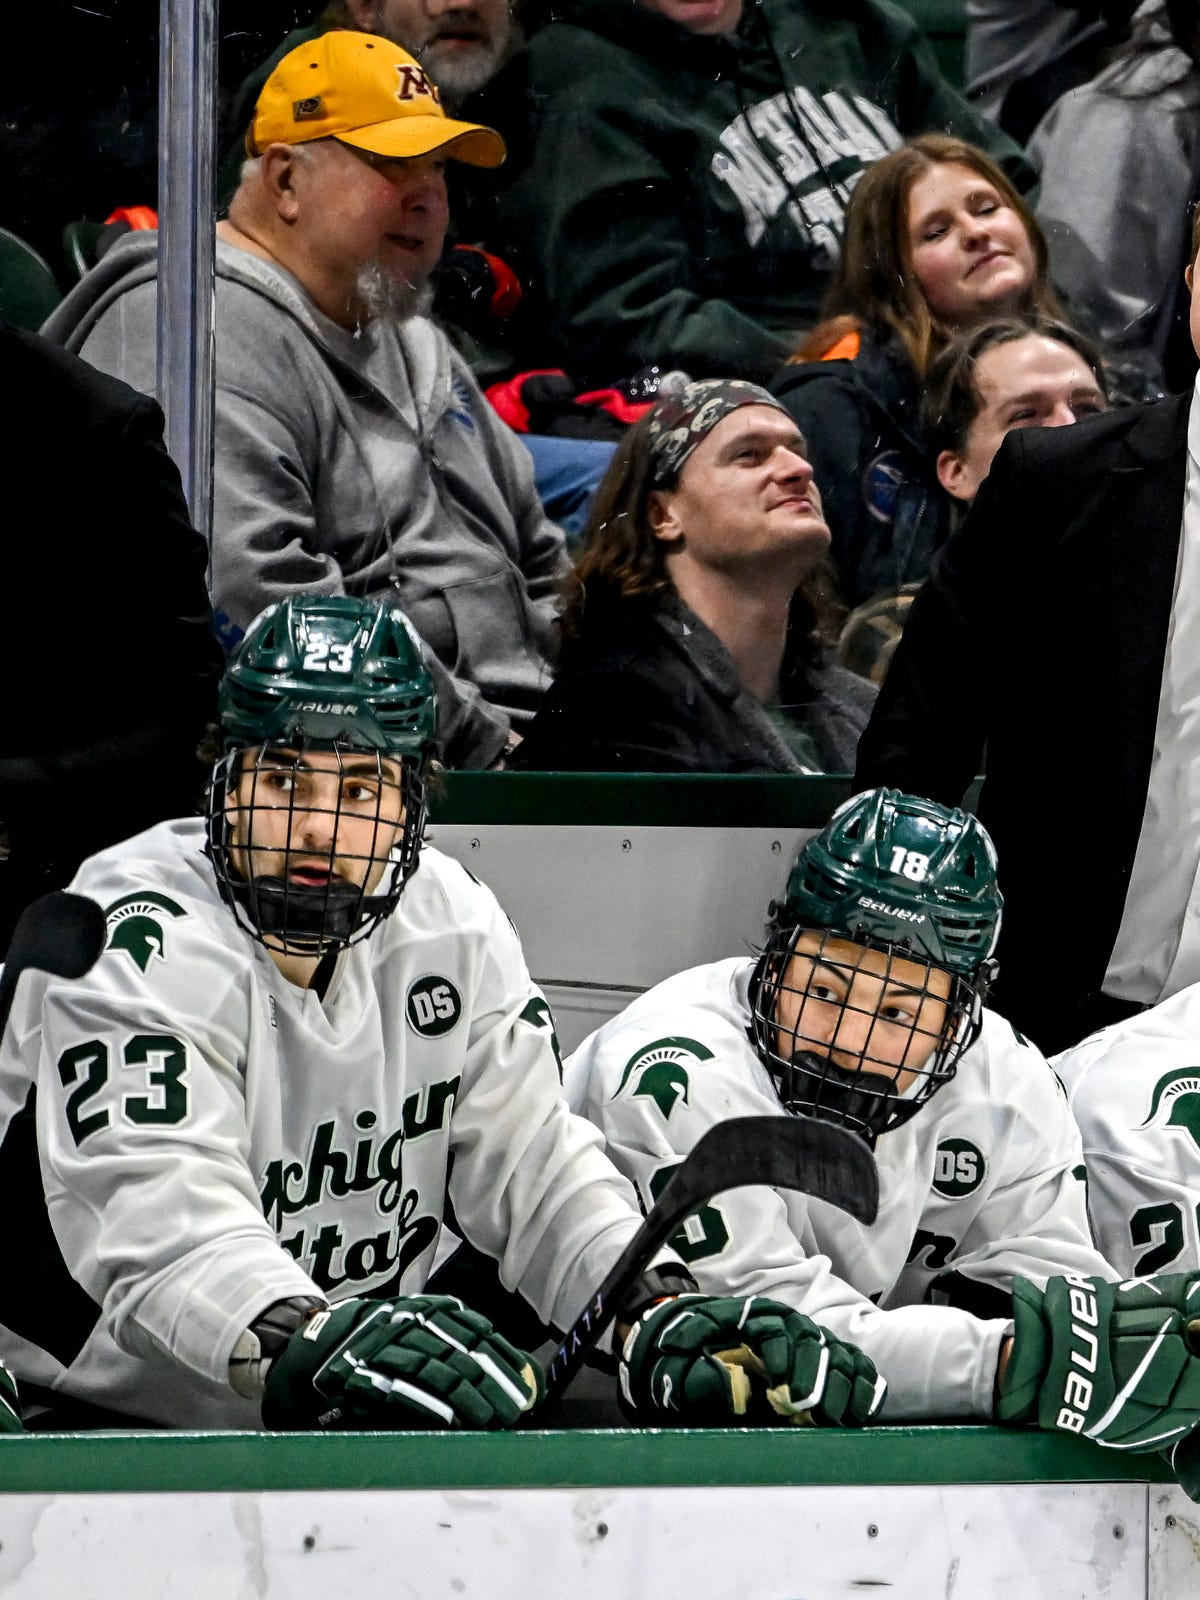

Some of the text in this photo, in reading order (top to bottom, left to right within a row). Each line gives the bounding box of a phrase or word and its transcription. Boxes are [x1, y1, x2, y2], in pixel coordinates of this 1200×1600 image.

[303, 642, 354, 673] 23
[889, 846, 930, 883] 18
[411, 984, 456, 1027] DS
[56, 1033, 190, 1149] 23
[933, 1150, 978, 1184] DS
